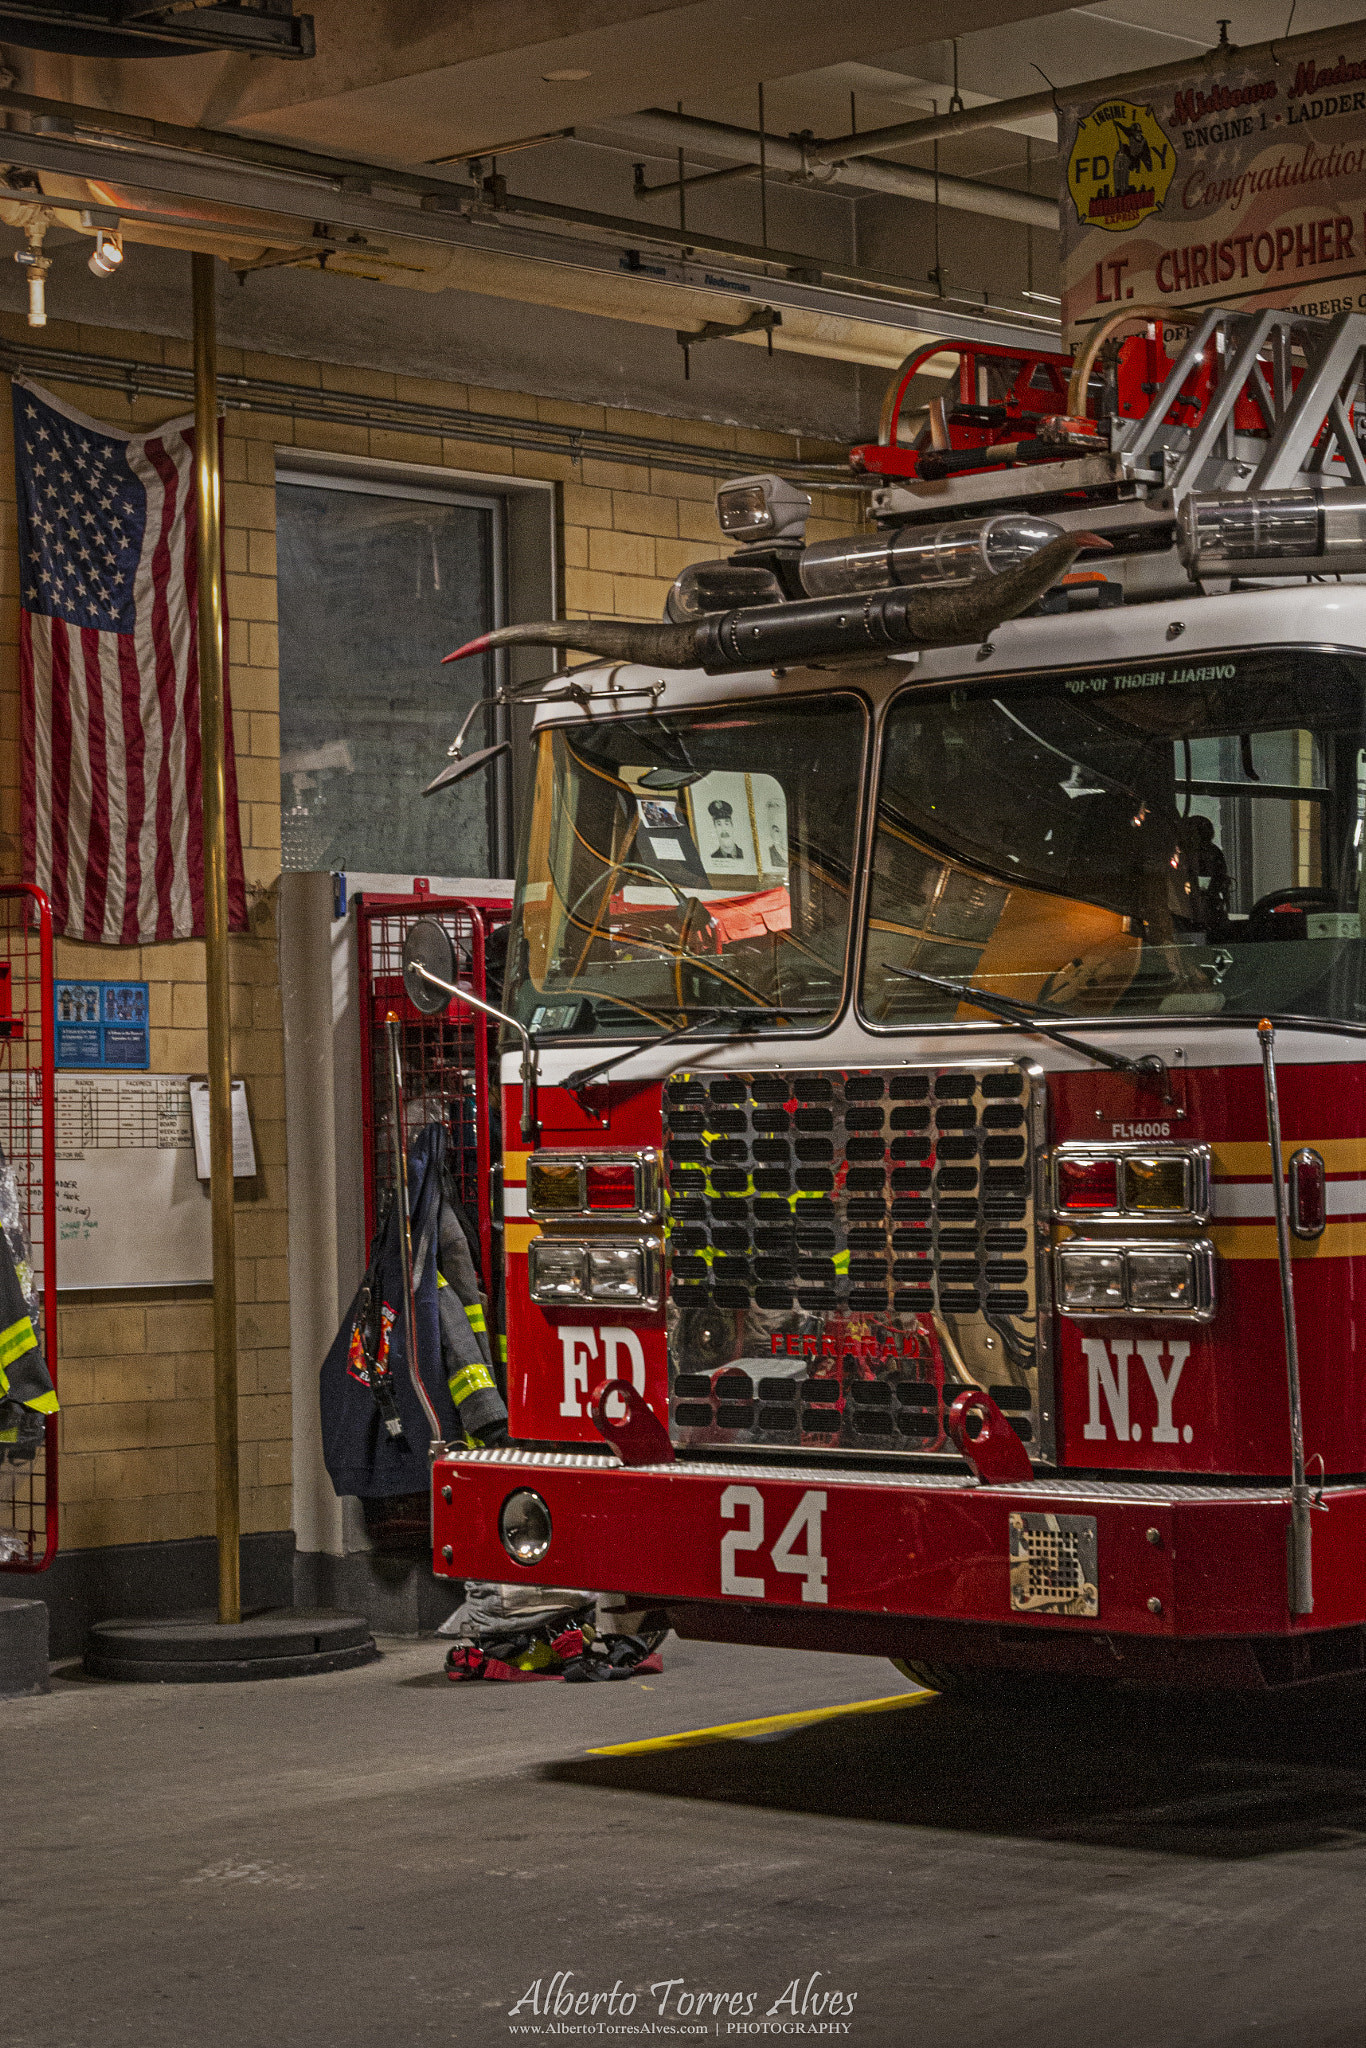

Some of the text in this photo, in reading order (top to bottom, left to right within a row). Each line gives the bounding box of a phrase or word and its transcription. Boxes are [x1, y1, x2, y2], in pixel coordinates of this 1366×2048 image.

[1092, 106, 1126, 126] ENGINE
[1169, 80, 1278, 127] Midtown
[1182, 92, 1366, 149] ENGINE 1 LADDER
[1076, 155, 1110, 184] FD
[619, 258, 667, 275] Nerman
[1095, 215, 1355, 304] LT. CHRISTOPHER
[705, 274, 751, 293] Nederman
[1281, 296, 1353, 317] MBERS
[1112, 1122, 1170, 1139] FL14006
[1081, 1337, 1194, 1444] N.Y.
[720, 1484, 829, 1604] 24
